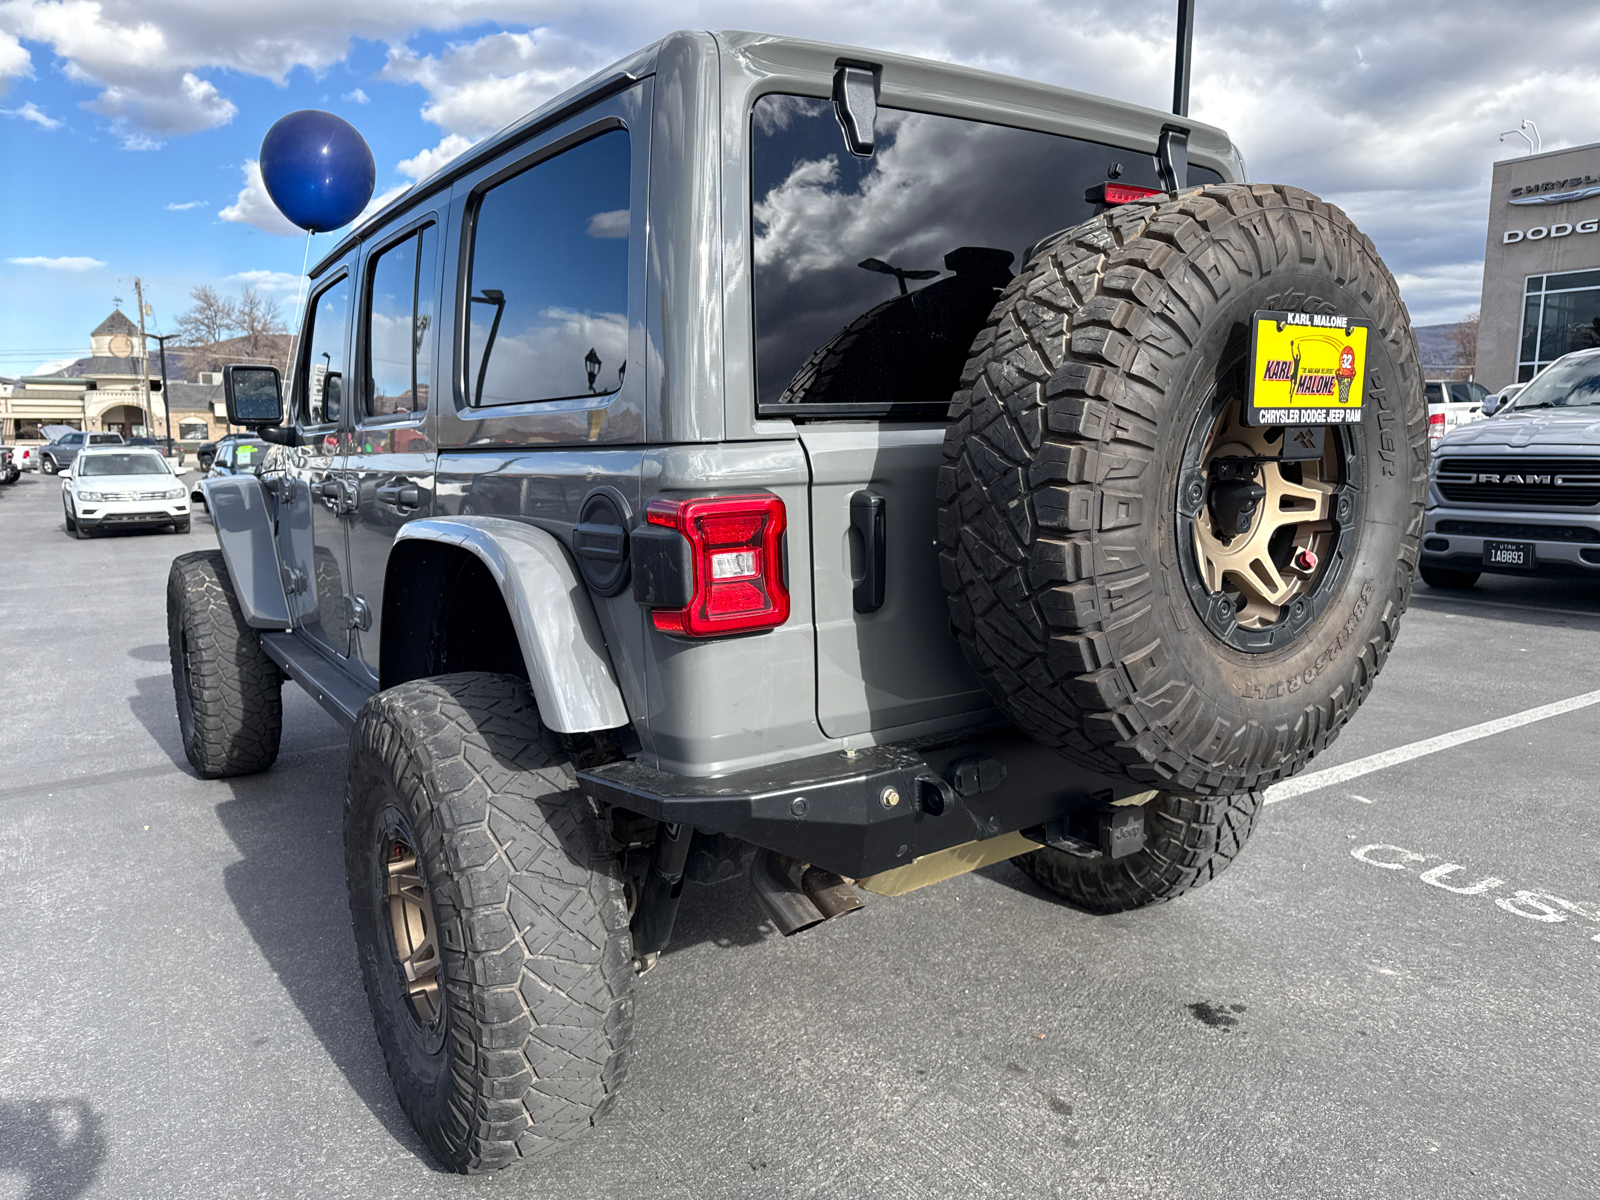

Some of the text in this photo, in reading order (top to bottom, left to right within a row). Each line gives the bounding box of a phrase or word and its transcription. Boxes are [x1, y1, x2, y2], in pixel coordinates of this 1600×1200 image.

[1511, 175, 1600, 196] CHRYSL
[1503, 218, 1599, 244] DODG
[1287, 312, 1348, 328] KARL MALONE
[1263, 359, 1292, 381] KARL
[1341, 353, 1353, 369] 32
[1295, 374, 1336, 396] MALONE
[1259, 409, 1361, 424] CHRYSLER DODGE JEEP RAM
[1478, 473, 1551, 484] RAM
[1115, 824, 1140, 841] Jeep
[1350, 843, 1600, 942] CUS
